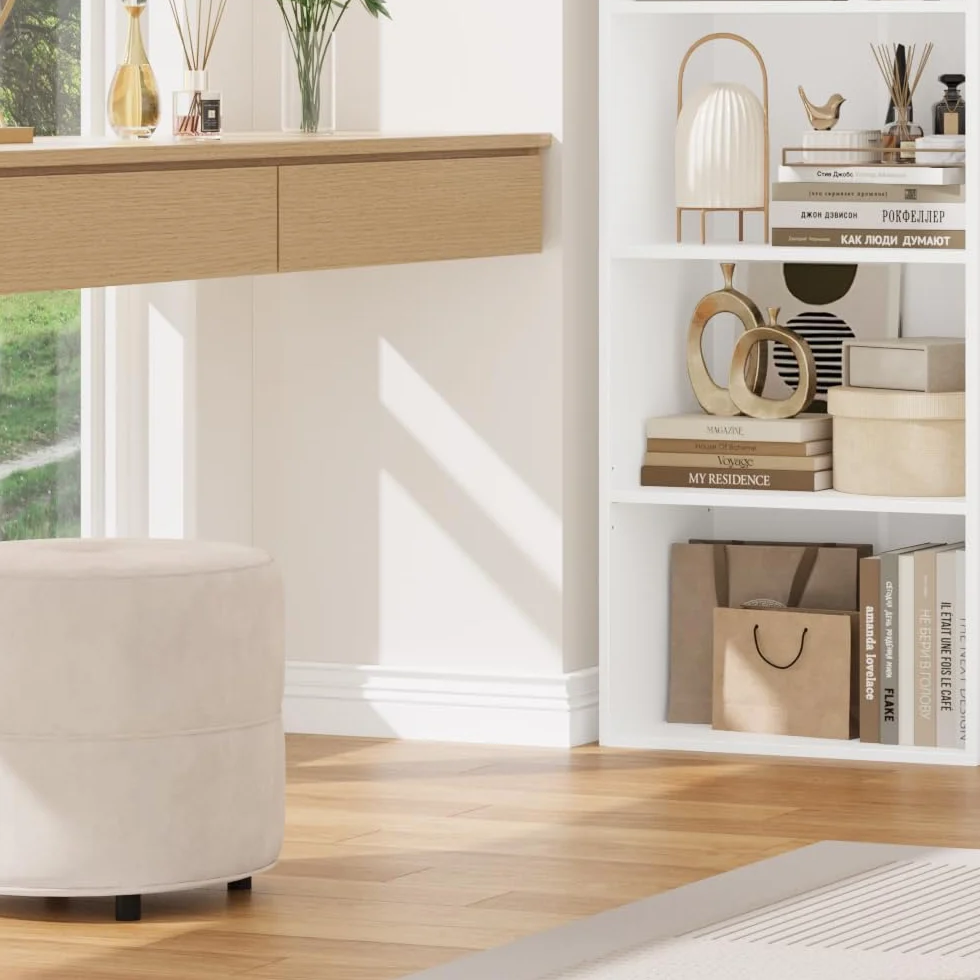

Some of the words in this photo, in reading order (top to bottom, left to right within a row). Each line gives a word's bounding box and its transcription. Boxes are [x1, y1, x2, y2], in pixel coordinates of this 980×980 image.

[816, 170, 832, 178] Стив
[832, 170, 854, 179] Джобс
[882, 209, 945, 223] РОКФЕЛЛЕР
[840, 234, 862, 245] КАК
[864, 235, 898, 246] ЛЮДИ
[902, 236, 951, 247] ДУМАЮТ
[706, 426, 744, 436] MAGAZINE
[717, 455, 754, 468] Voyage
[688, 472, 707, 484] MY
[708, 473, 771, 486] RESIDENCE
[940, 602, 952, 610] IL
[919, 609, 932, 626] НЕ
[866, 606, 876, 650] amanda
[919, 627, 932, 658] БЕРИ
[940, 637, 952, 655] UNE
[919, 661, 932, 669] В
[940, 656, 952, 676] FOIS
[866, 654, 876, 701] lovelace
[940, 677, 952, 688] LE
[919, 672, 932, 720] ГОЛОВУ
[884, 688, 894, 721] FLAKE
